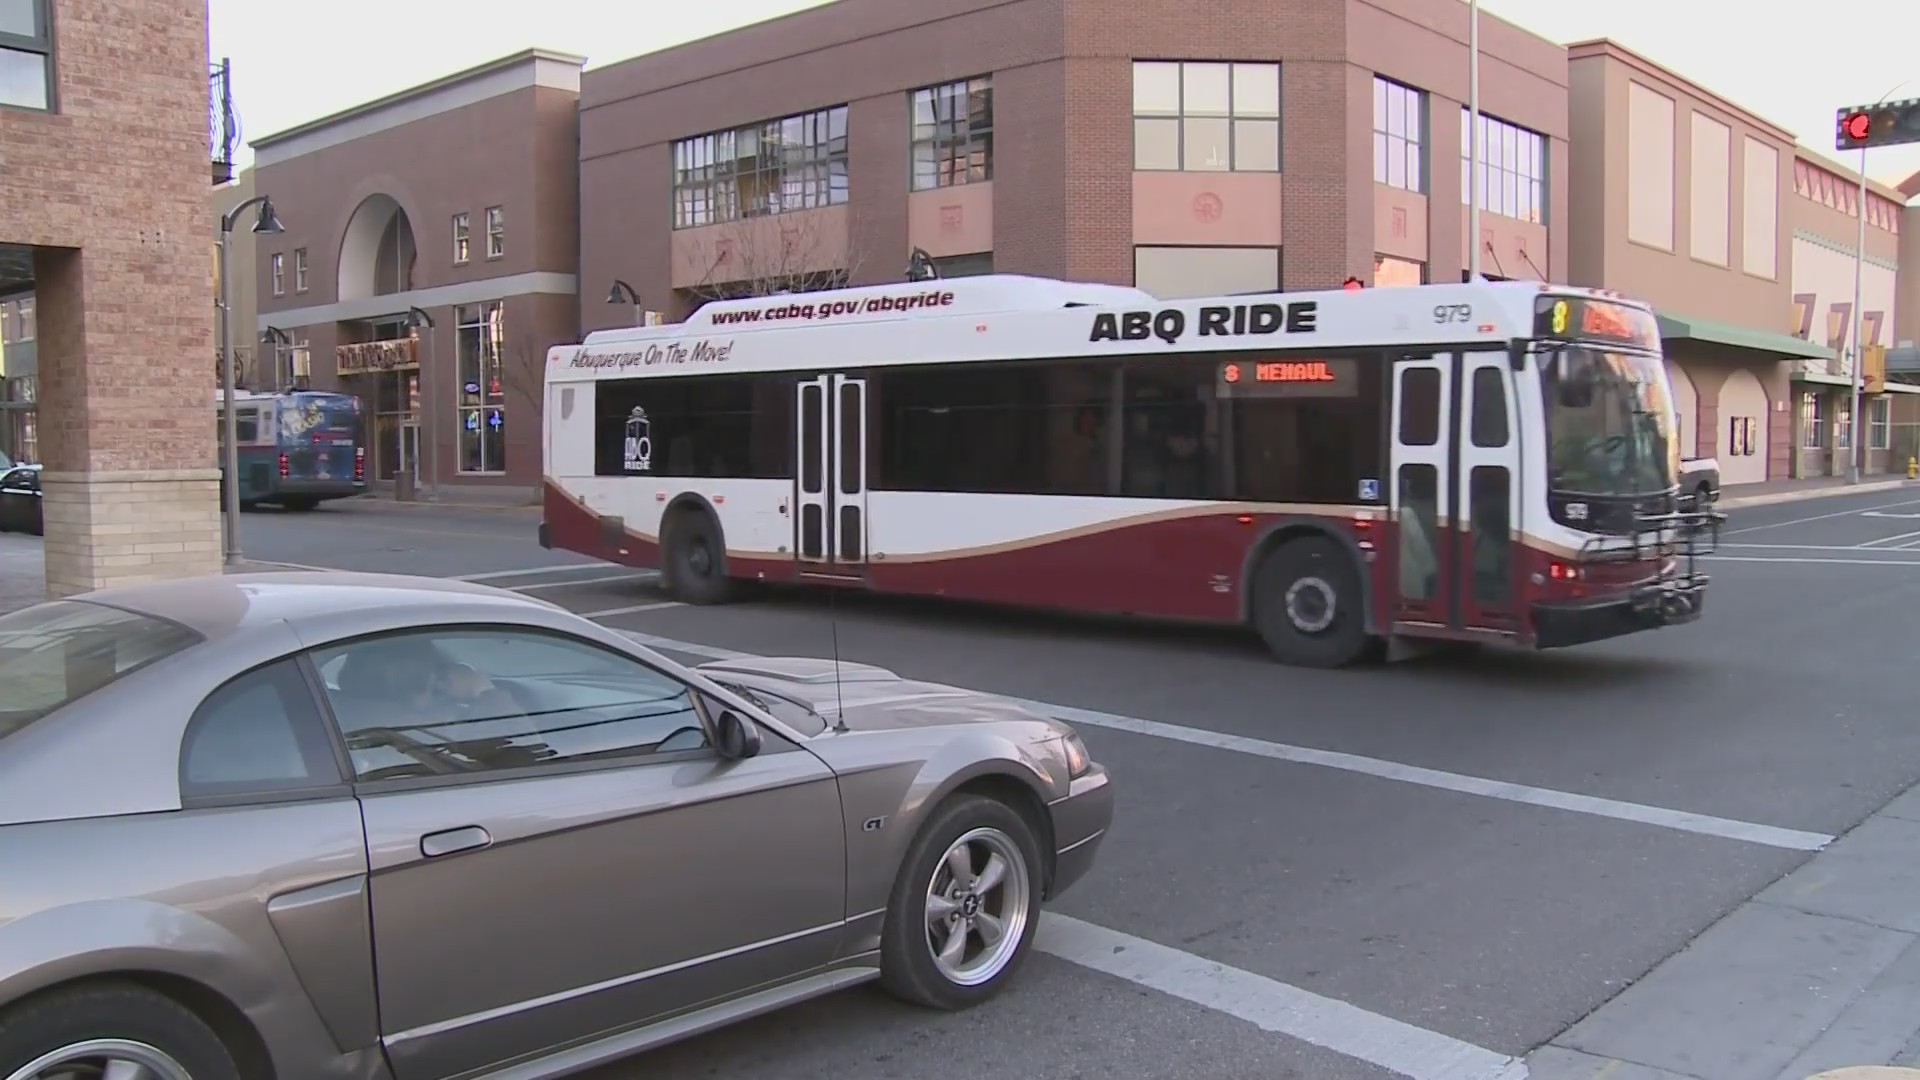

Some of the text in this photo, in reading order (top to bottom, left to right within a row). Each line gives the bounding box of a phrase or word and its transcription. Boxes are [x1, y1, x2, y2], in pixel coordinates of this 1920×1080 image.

[711, 290, 954, 326] www.cabq.gov/abqride
[1089, 301, 1317, 344] ABQ RIDE
[1433, 303, 1472, 324] 979
[1552, 300, 1568, 334] 8
[569, 339, 735, 373] Albuquerque On The Move!
[1256, 362, 1334, 381] MENAUL
[862, 815, 888, 831] GT
